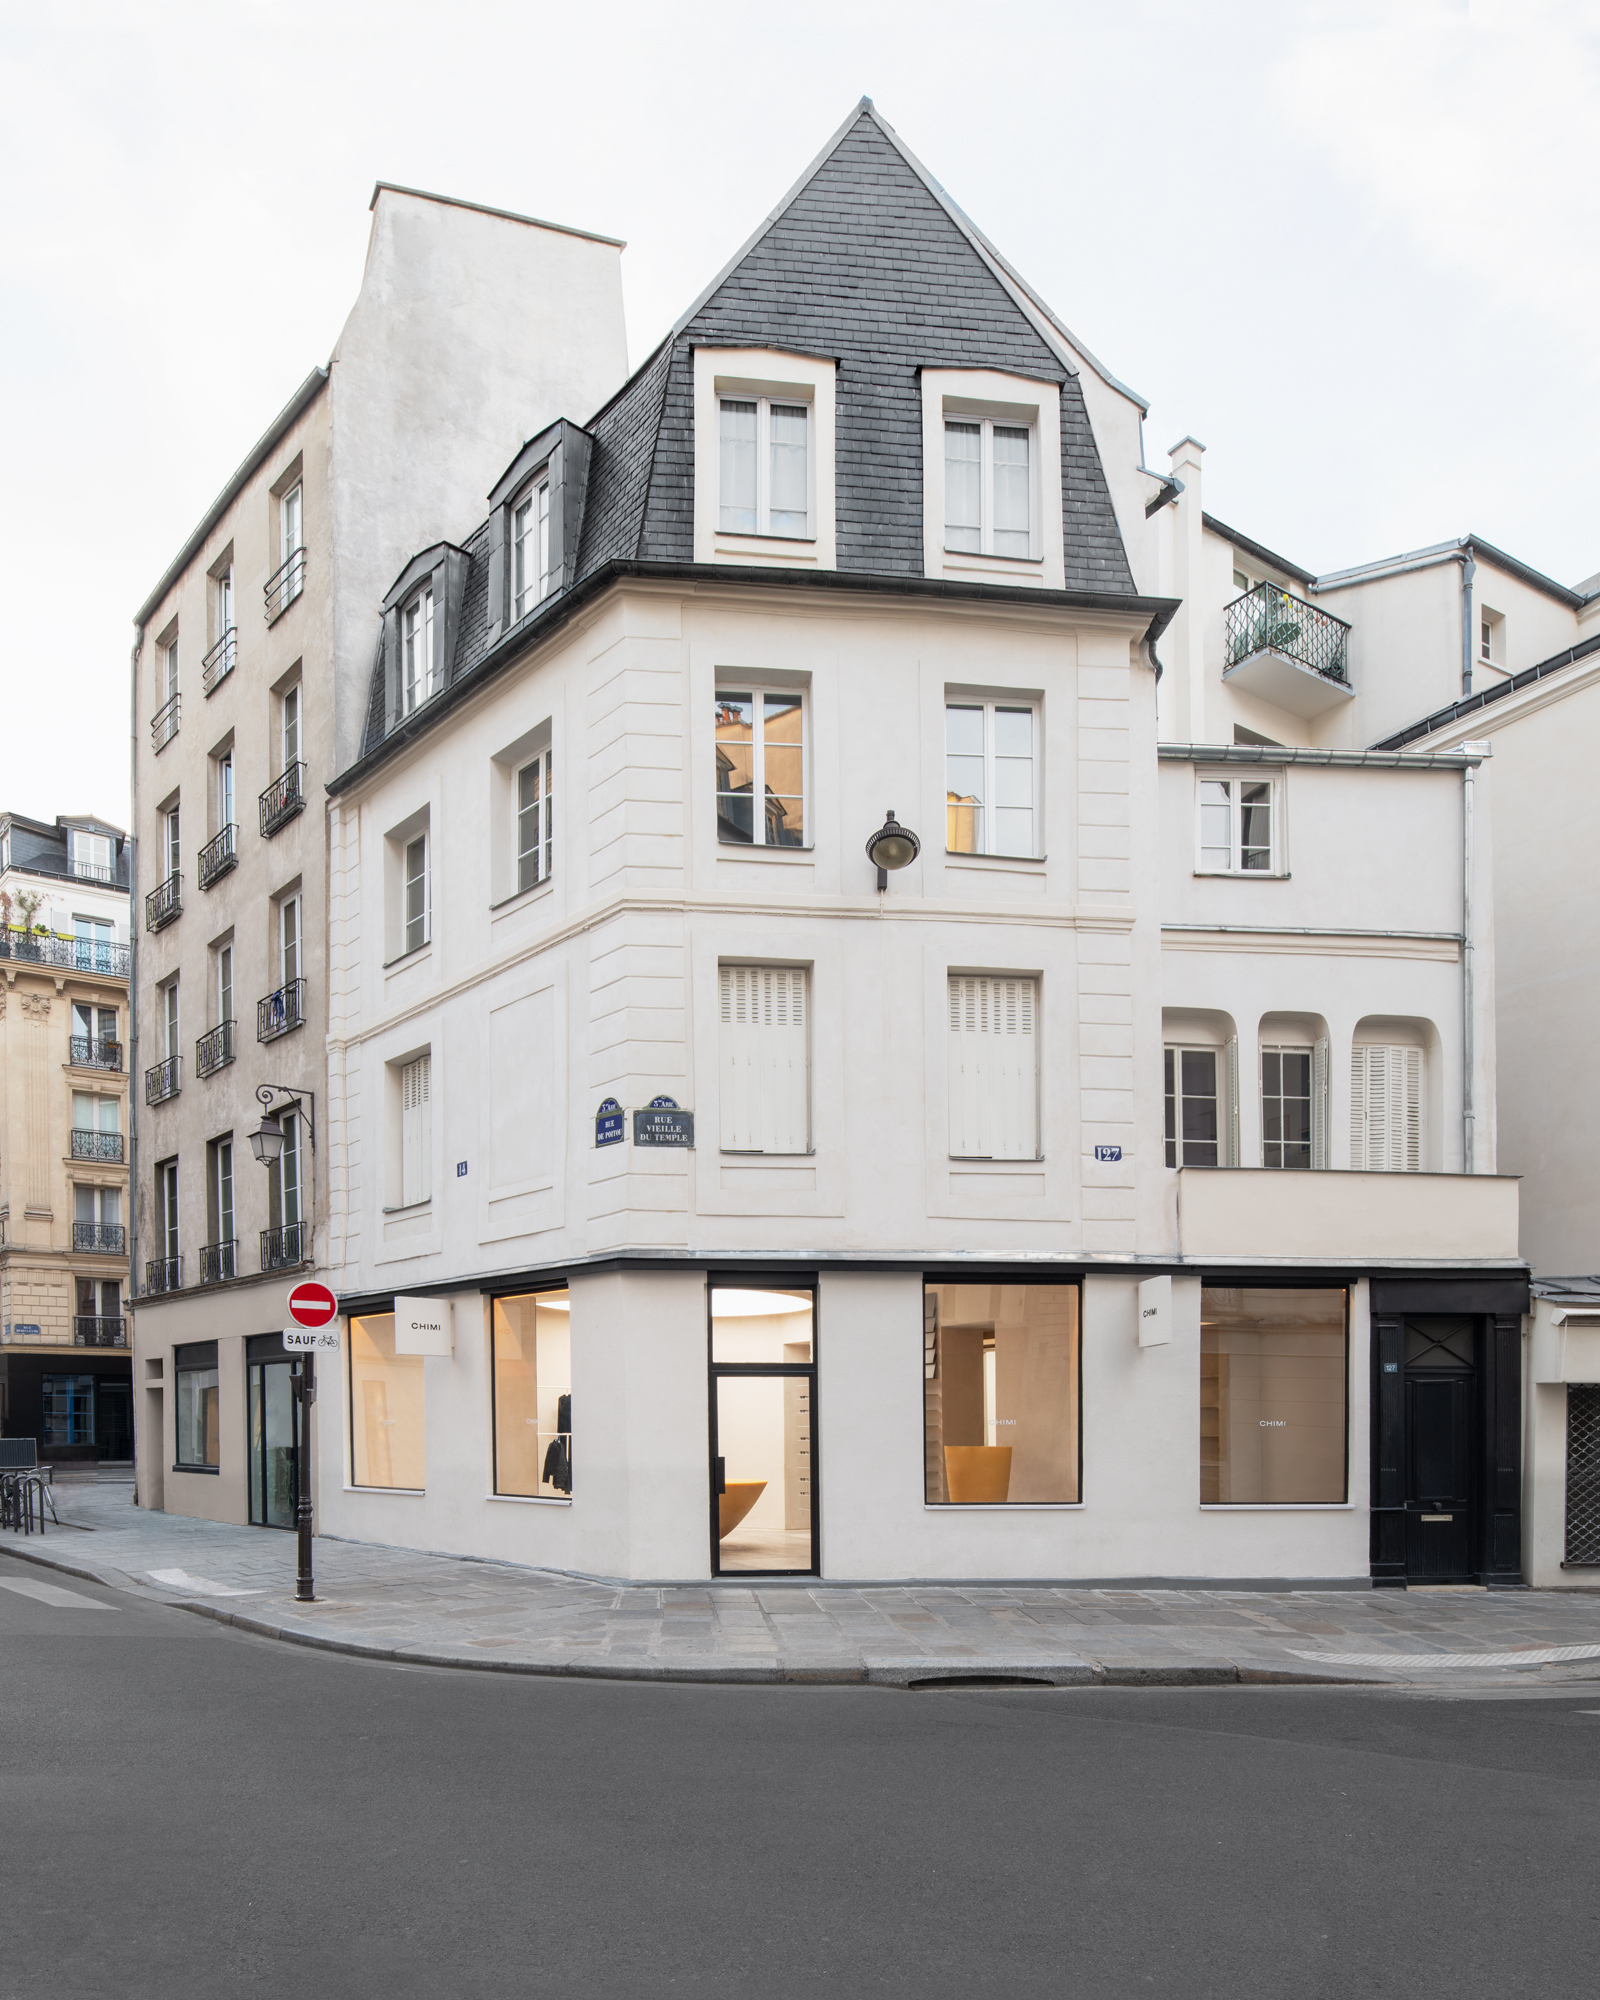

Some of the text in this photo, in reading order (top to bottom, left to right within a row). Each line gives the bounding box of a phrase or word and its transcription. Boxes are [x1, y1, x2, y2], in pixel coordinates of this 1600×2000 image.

[605, 1120, 615, 1128] RUE
[605, 1129, 622, 1138] POITOU
[654, 1133, 688, 1141] TEMPLE
[1097, 1147, 1120, 1160] 127
[1143, 1308, 1157, 1318] CHIMI
[411, 1322, 441, 1331] CHIMI
[287, 1335, 316, 1345] SAUF
